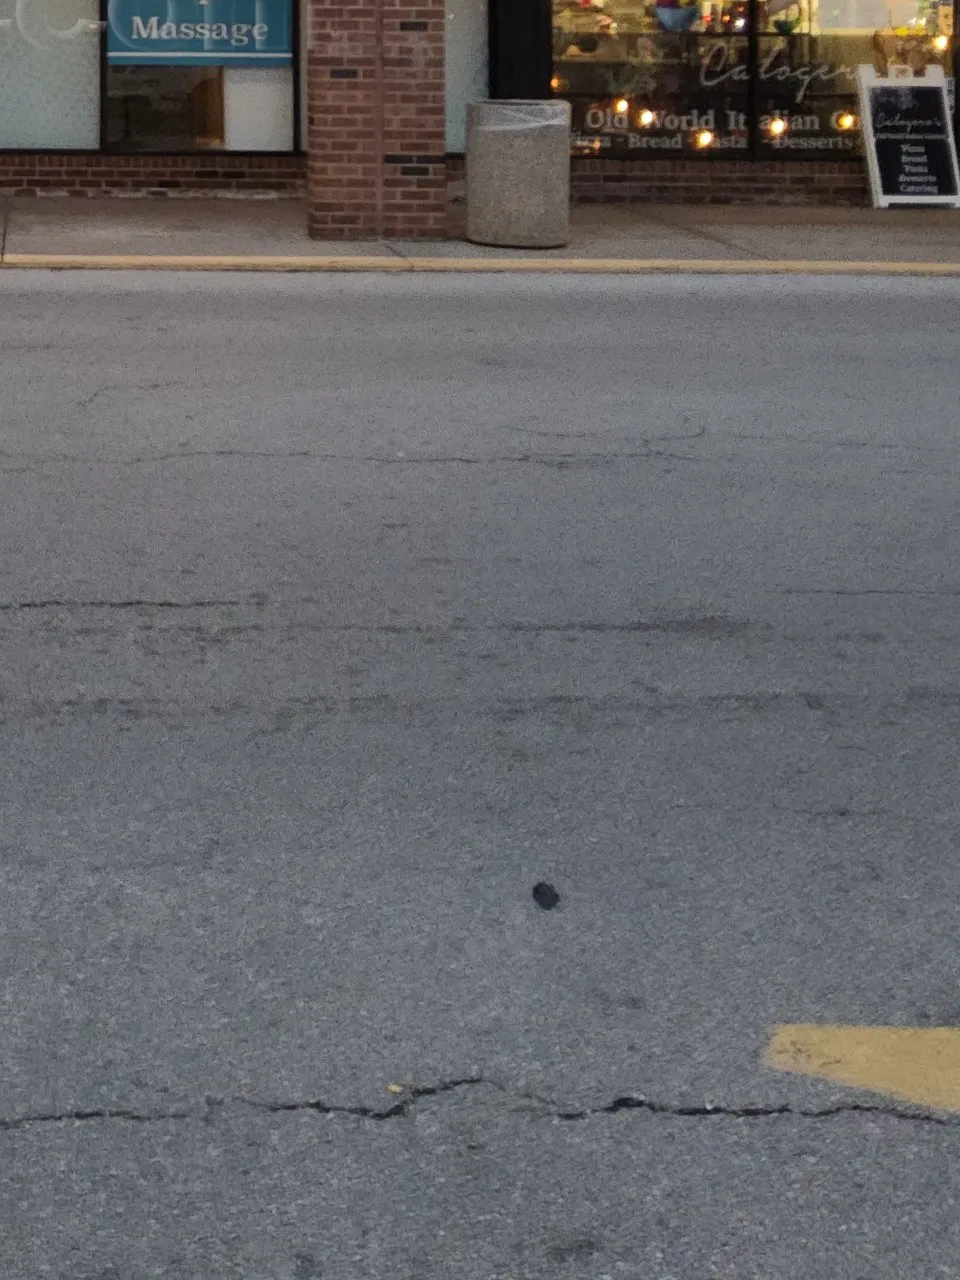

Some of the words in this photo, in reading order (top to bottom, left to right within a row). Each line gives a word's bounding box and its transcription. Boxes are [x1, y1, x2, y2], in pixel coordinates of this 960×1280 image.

[131, 16, 268, 46] Massage
[586, 108, 629, 129] Old
[628, 133, 682, 149] Bread
